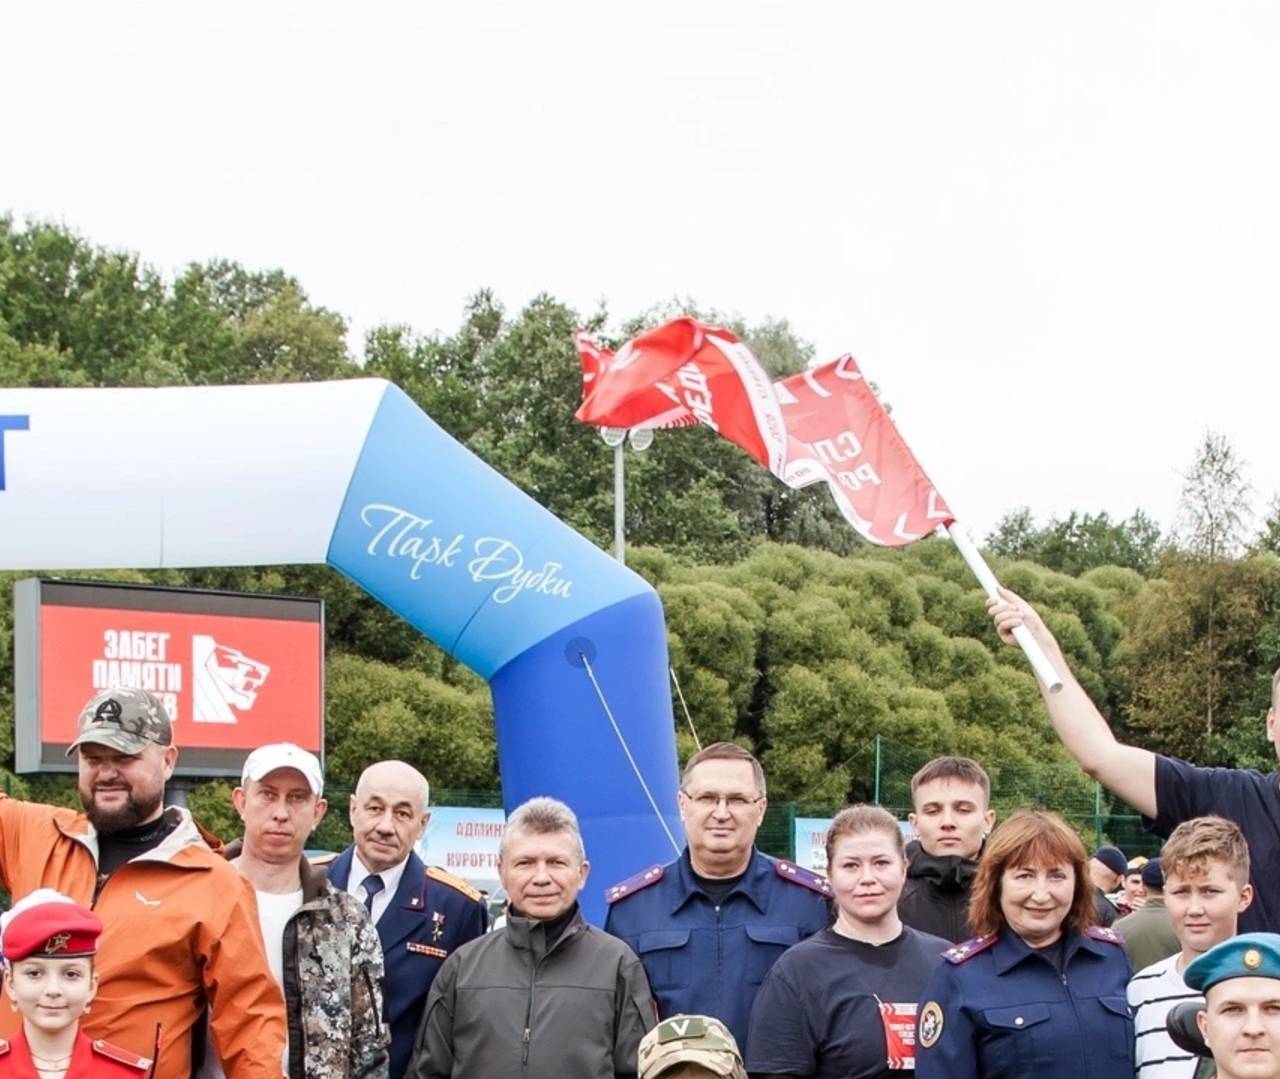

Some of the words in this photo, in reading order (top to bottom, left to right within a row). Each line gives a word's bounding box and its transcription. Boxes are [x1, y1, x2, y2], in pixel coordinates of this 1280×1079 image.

[360, 503, 465, 580] Парк
[468, 537, 573, 604] Дубки
[103, 629, 170, 661] ЗАБЕГ
[92, 660, 181, 692] ПАМЯТИ
[456, 822, 505, 837] АДМИН
[670, 1020, 690, 1036] V
